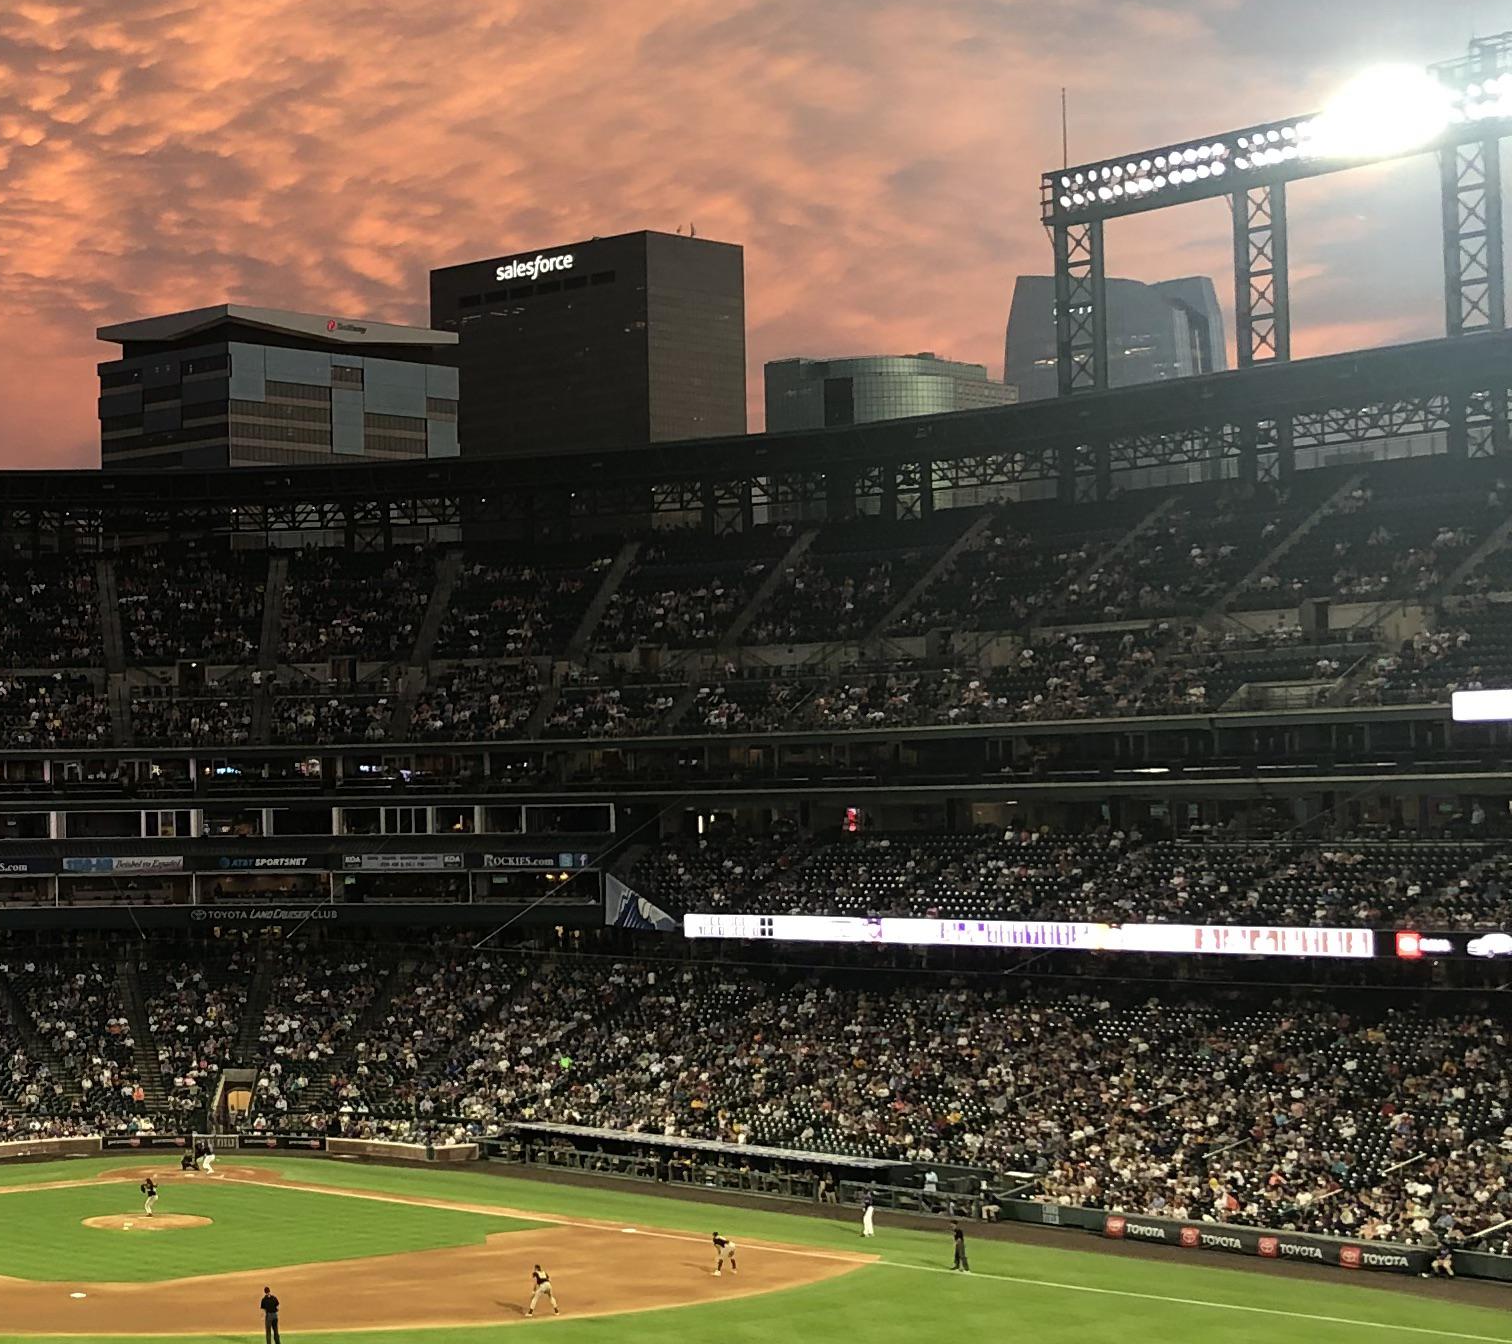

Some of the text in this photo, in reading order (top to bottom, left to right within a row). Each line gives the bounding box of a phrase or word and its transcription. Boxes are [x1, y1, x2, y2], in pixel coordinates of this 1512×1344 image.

[496, 255, 573, 281] salesforce
[255, 856, 308, 866] SPORTSNET
[483, 854, 554, 867] ROCKIES.com
[208, 910, 248, 919] TOYOTA
[311, 910, 338, 919] CLUB
[1126, 1222, 1165, 1238] TOYOTA
[1201, 1233, 1242, 1249] TOYOTA
[1280, 1243, 1323, 1259] TOYOTA
[1362, 1252, 1409, 1267] TOYOTA
